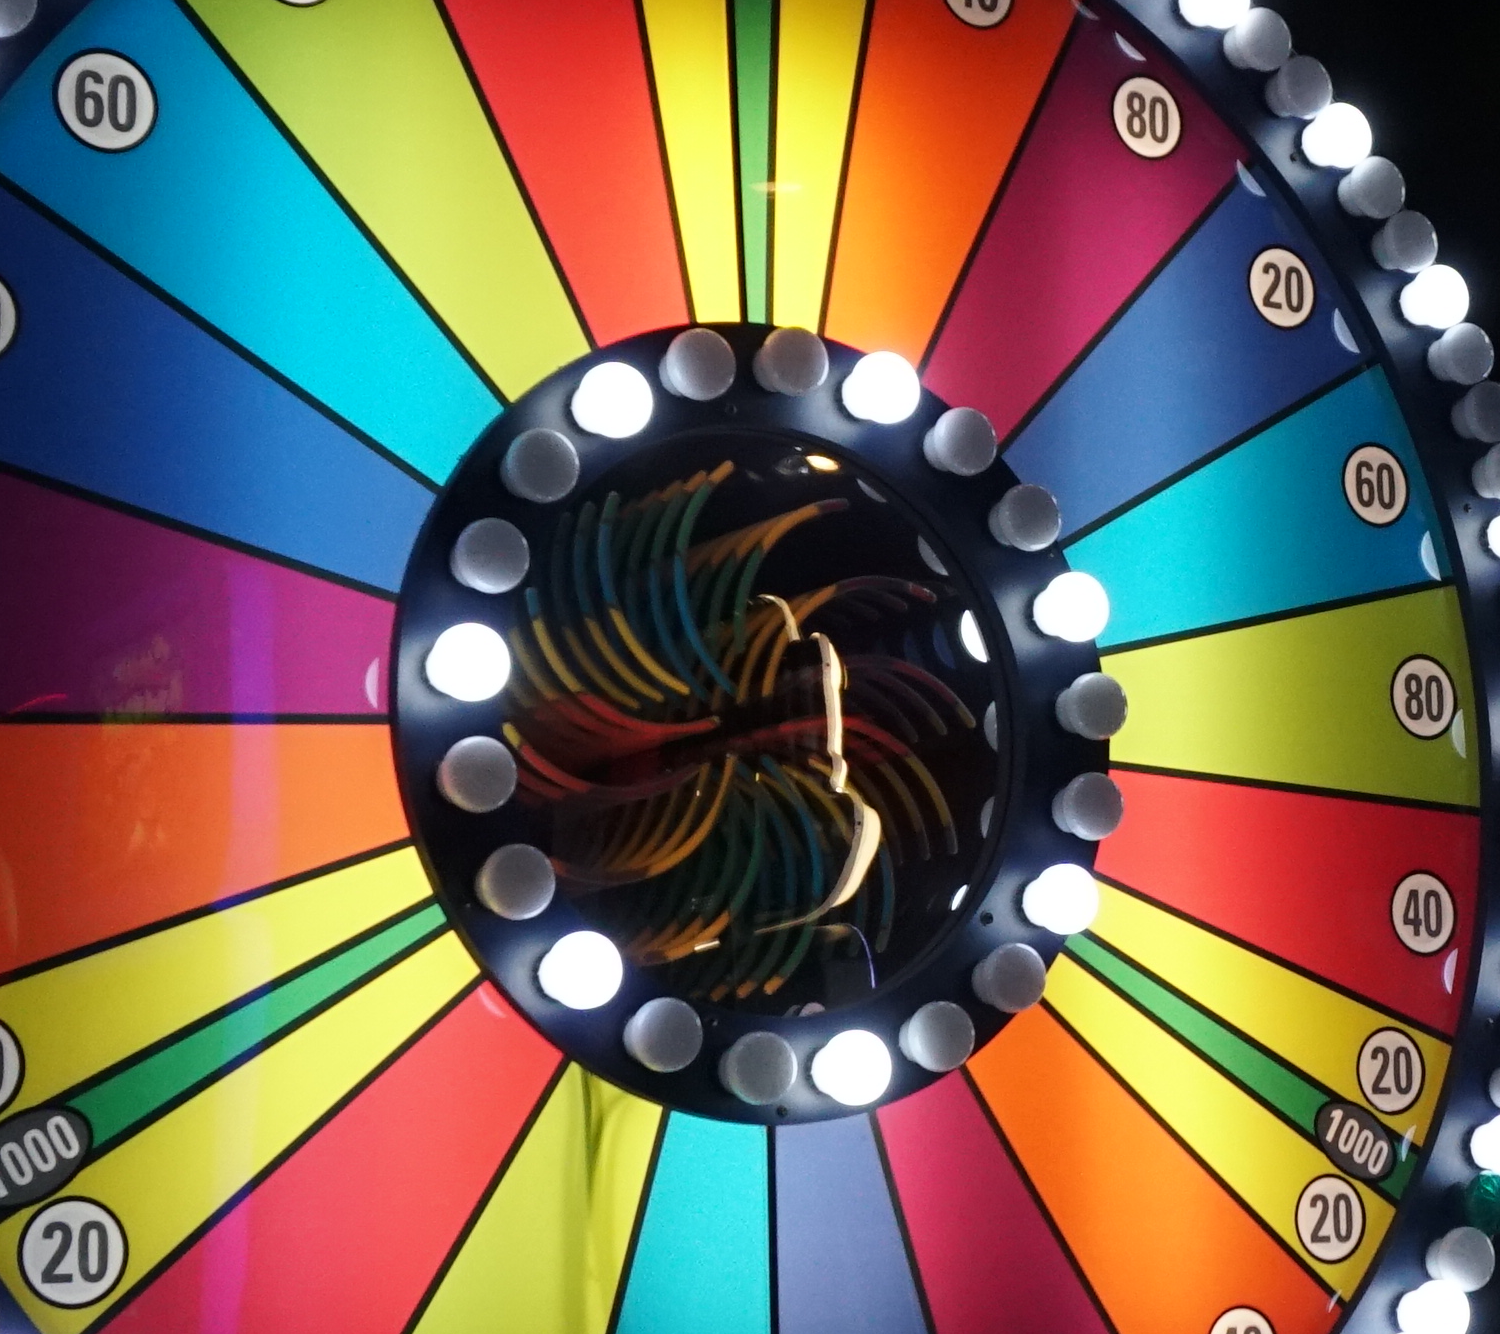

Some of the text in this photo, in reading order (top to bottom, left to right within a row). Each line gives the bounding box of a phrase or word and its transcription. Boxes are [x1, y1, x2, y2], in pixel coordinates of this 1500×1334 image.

[75, 70, 136, 132] 60
[1127, 91, 1168, 143] 80
[1263, 262, 1304, 313] 20
[1356, 461, 1395, 509] 60
[1405, 673, 1444, 722] 80
[1403, 889, 1442, 937] 40
[1371, 1047, 1409, 1095] 20
[1326, 1109, 1388, 1174] 1000
[1311, 1192, 1352, 1244] 20
[41, 1221, 108, 1283] 20
